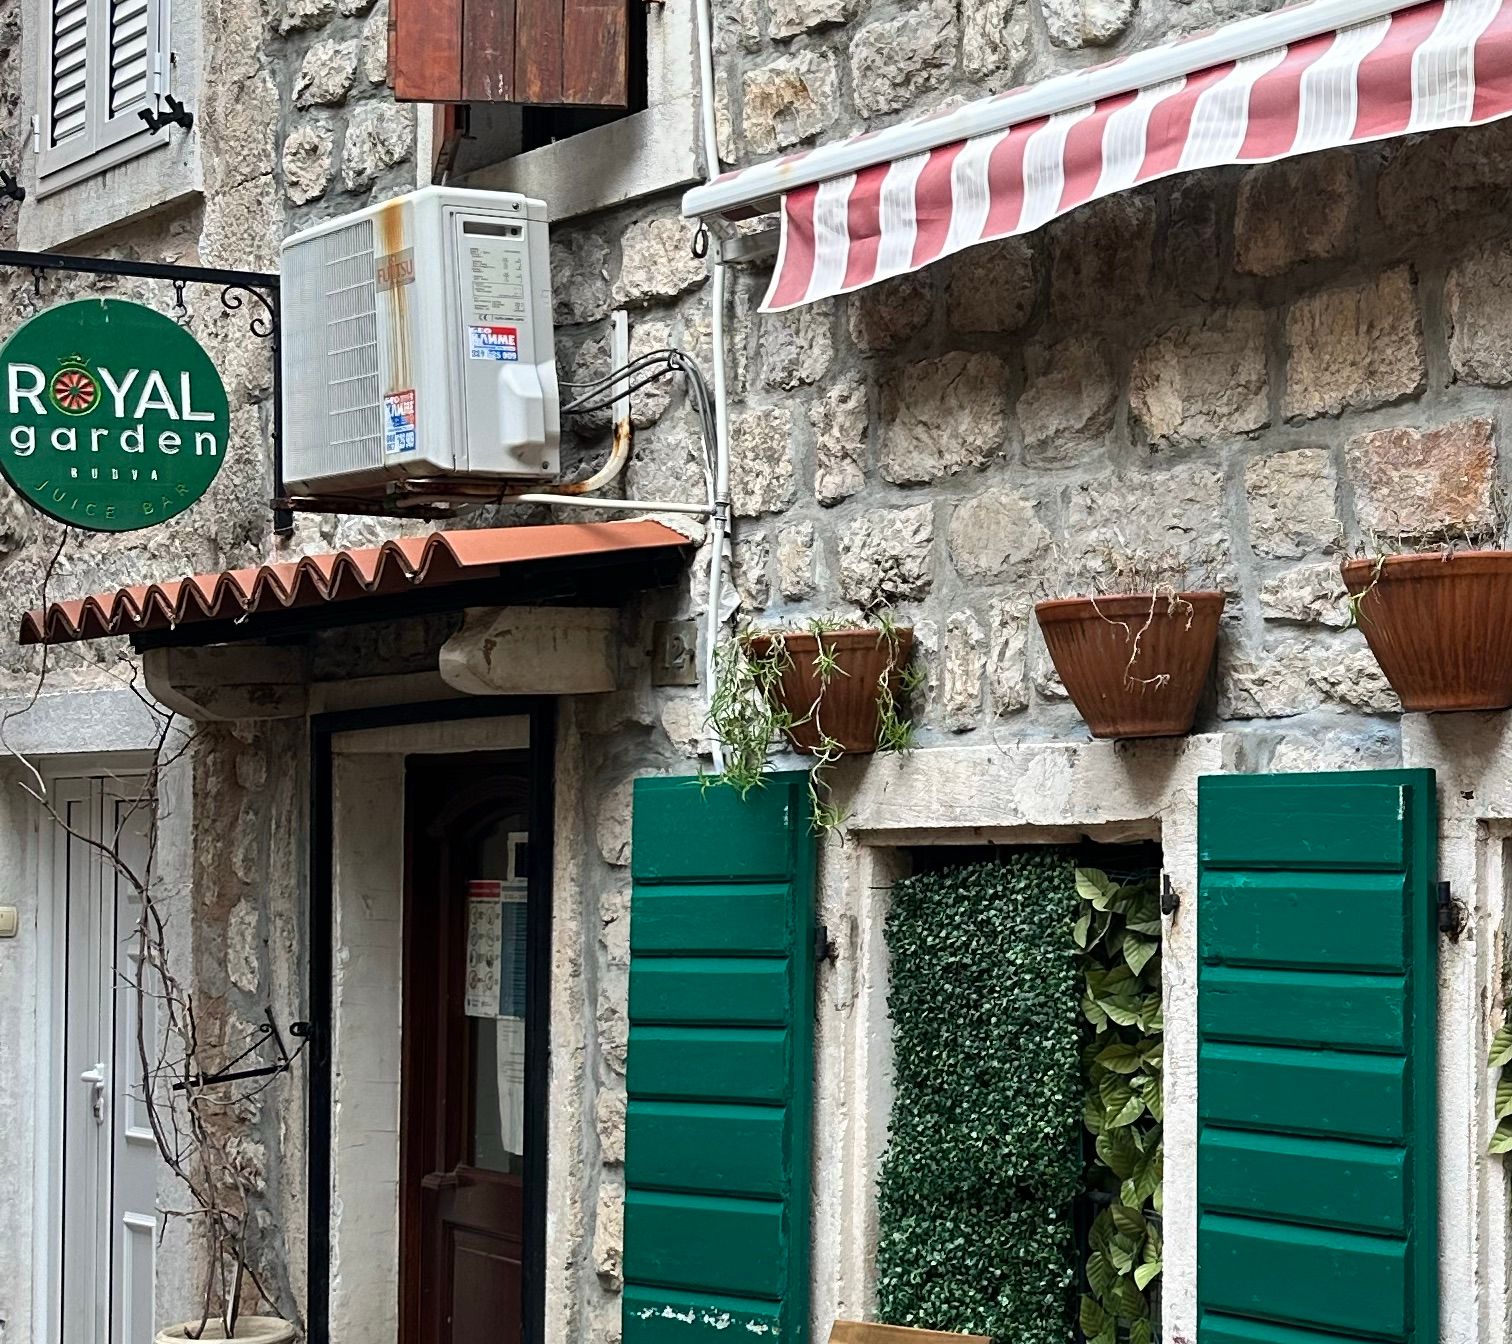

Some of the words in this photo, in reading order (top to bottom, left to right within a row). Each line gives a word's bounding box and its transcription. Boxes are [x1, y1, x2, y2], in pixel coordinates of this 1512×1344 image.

[8, 360, 216, 422] ROYAL
[10, 423, 218, 457] garden
[70, 467, 158, 481] BUDVA
[34, 479, 117, 519] JUICE
[142, 483, 189, 516] BAR
